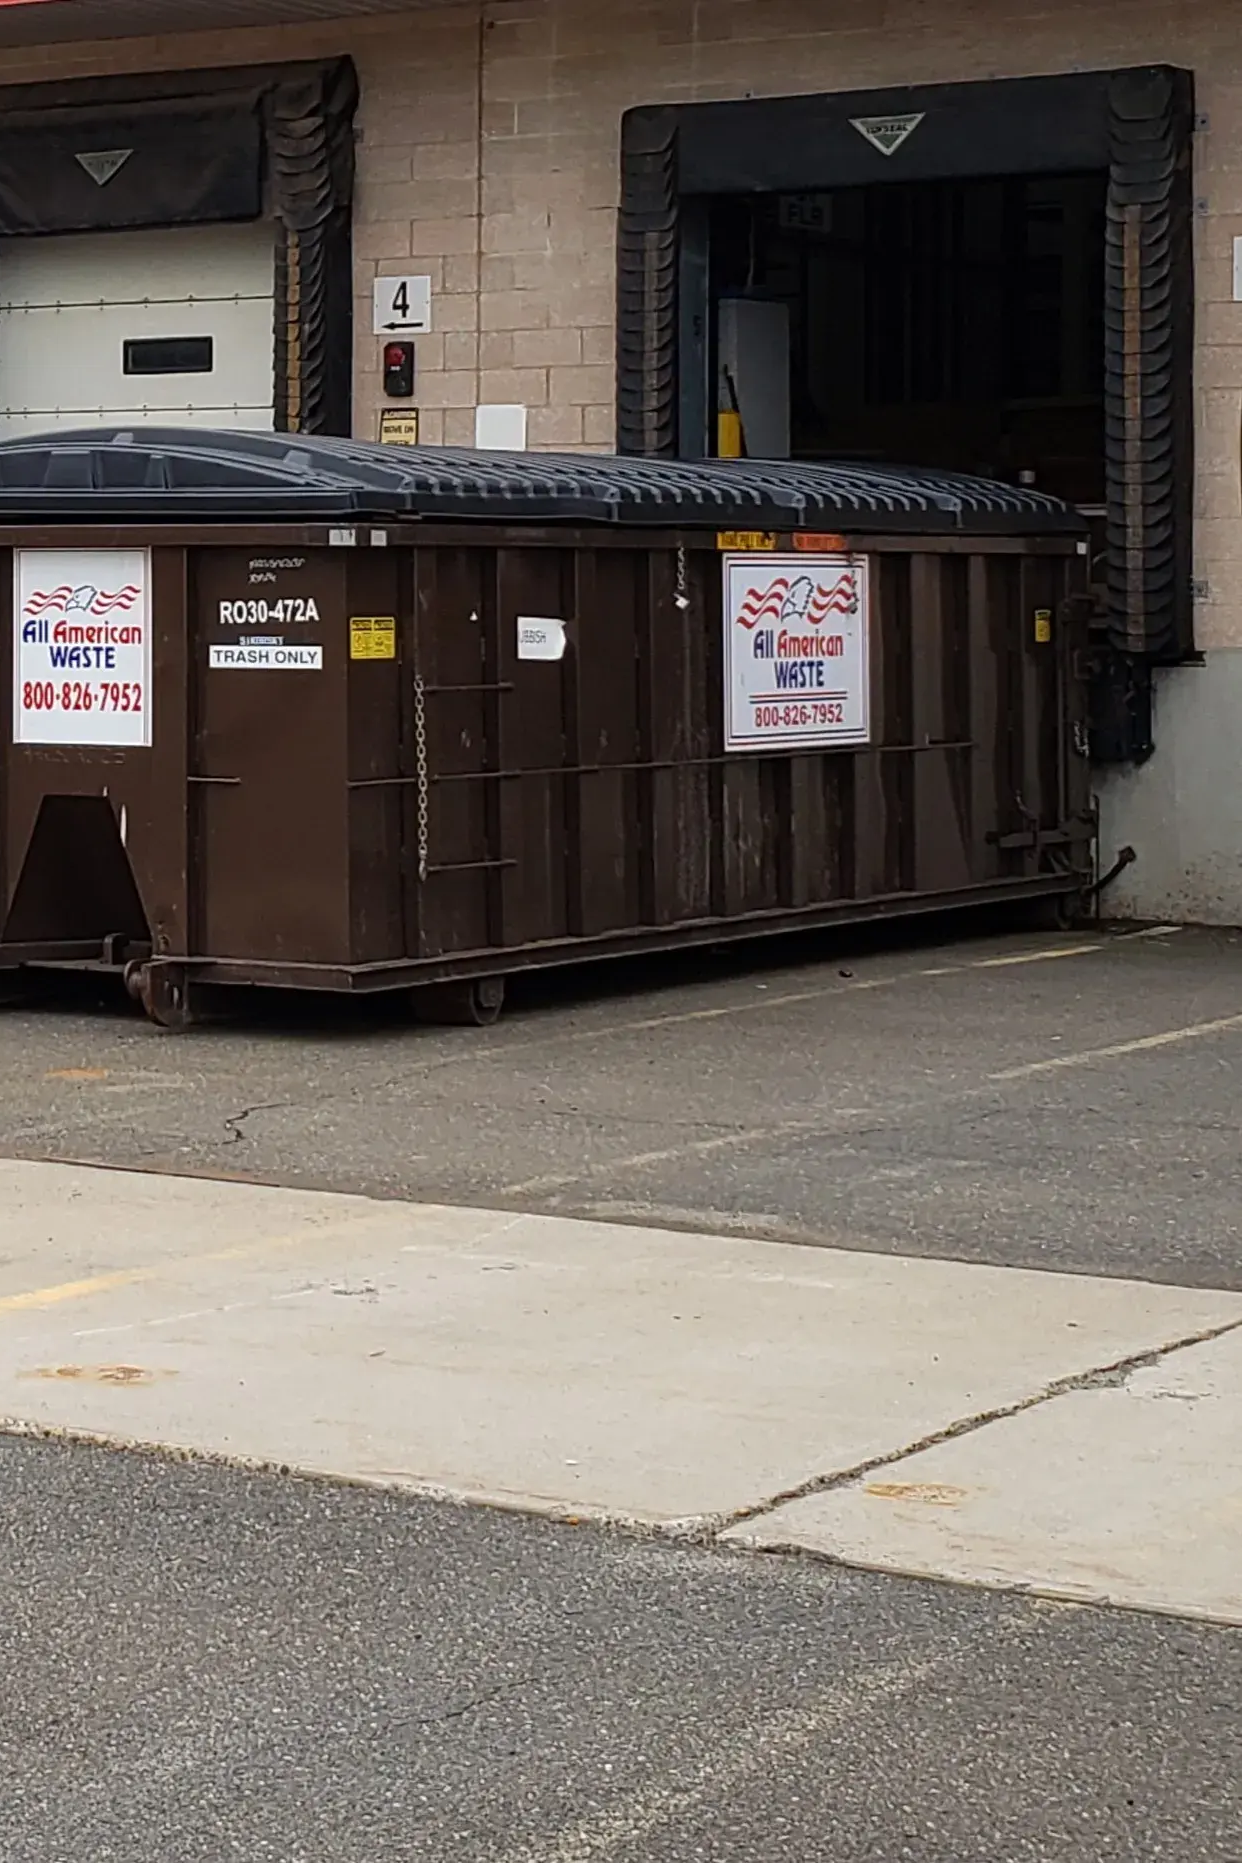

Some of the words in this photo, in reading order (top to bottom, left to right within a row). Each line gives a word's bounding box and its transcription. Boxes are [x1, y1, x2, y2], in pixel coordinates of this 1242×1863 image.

[392, 281, 410, 318] 4
[219, 598, 320, 624] RO30-472A
[23, 620, 48, 643] All
[53, 620, 142, 644] American
[753, 629, 774, 659] All
[777, 628, 843, 658] American
[49, 646, 116, 669] WASTE
[214, 650, 269, 664] TRASH
[275, 651, 318, 664] ONLY
[774, 660, 825, 689] WASTE
[754, 703, 843, 728] 800-826-7952
